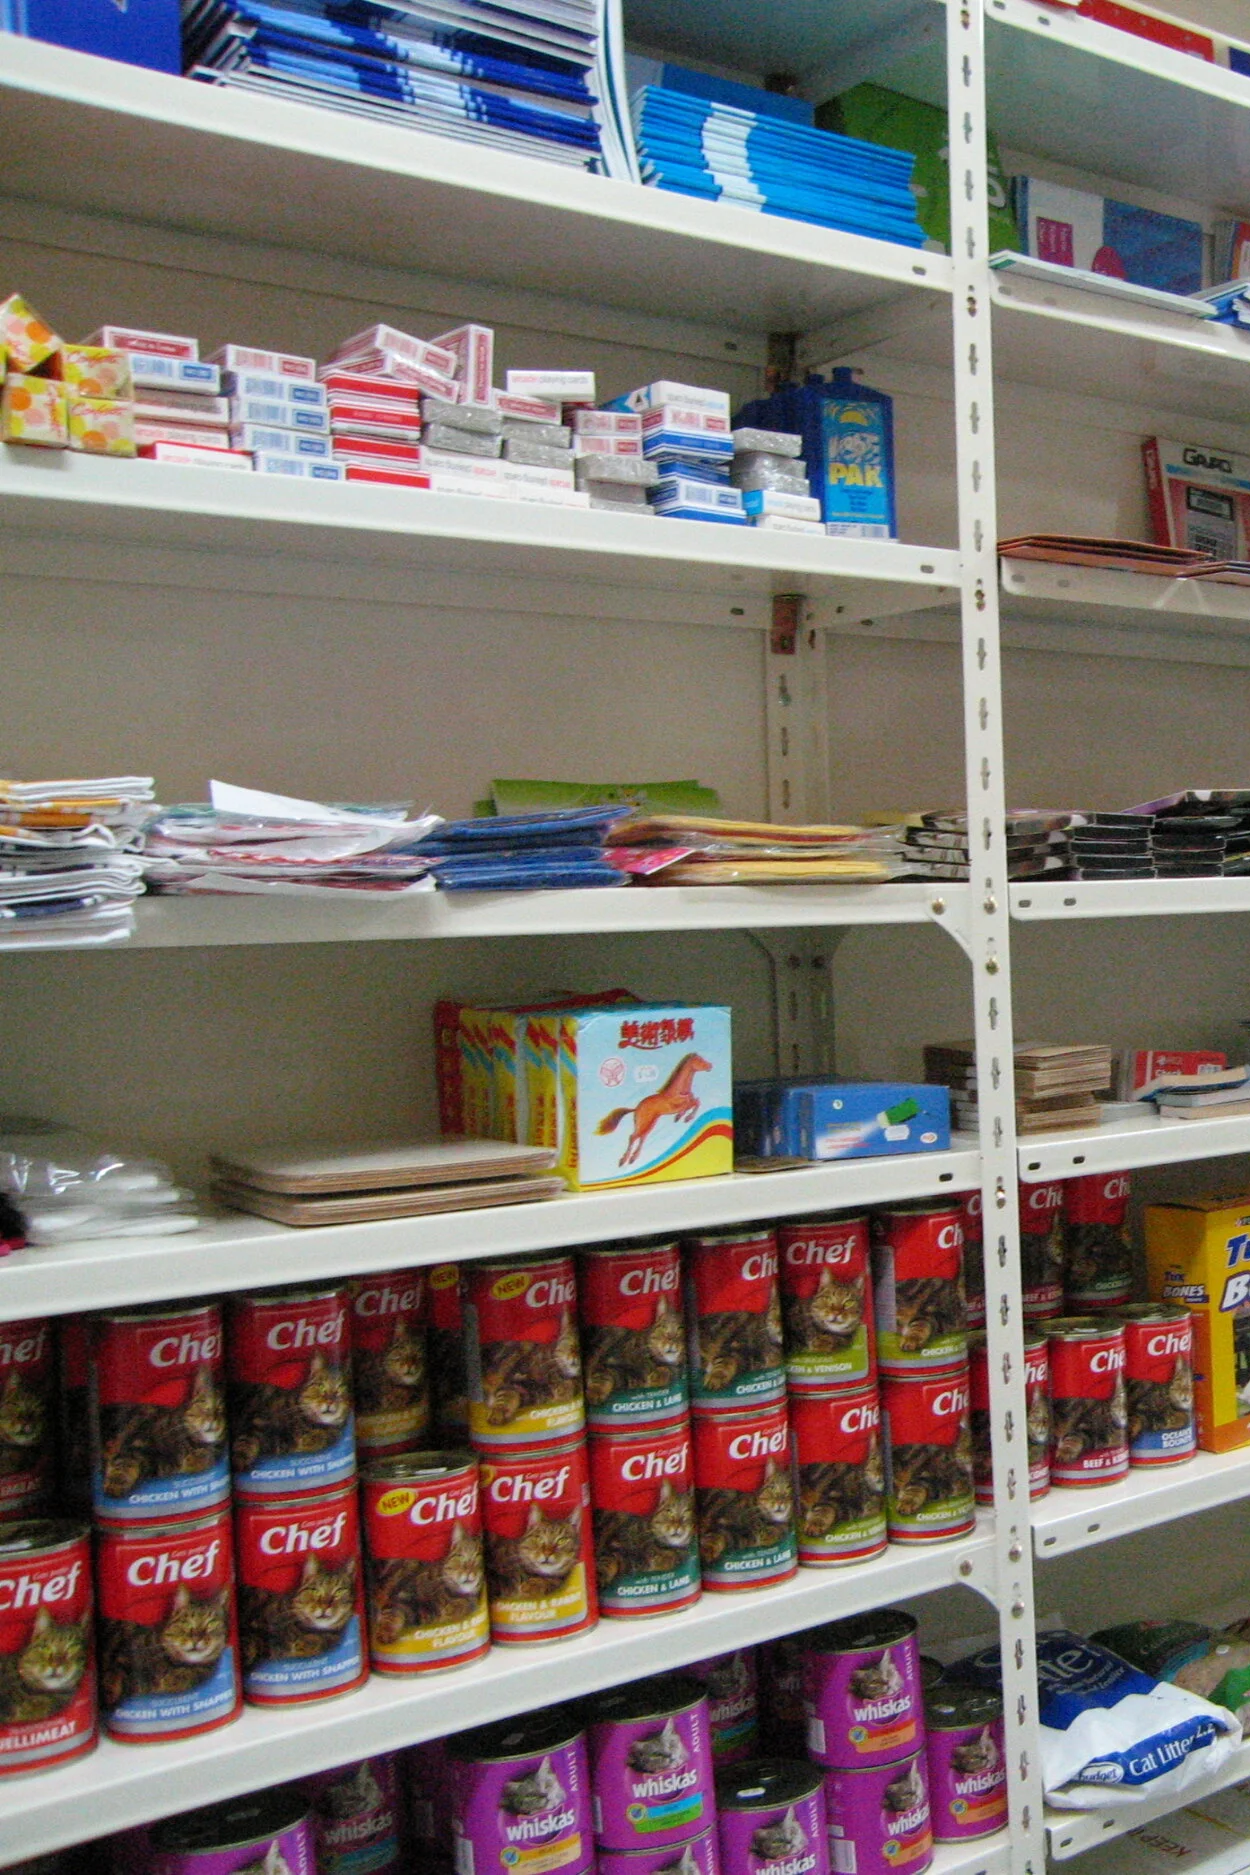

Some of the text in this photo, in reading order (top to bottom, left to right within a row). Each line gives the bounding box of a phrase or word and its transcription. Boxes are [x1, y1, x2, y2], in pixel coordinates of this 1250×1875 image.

[828, 462, 884, 487] PAK
[787, 1235, 856, 1266] Chef
[496, 1275, 527, 1295] NEW
[525, 1276, 577, 1309] Che
[267, 1308, 345, 1350] Chef
[813, 1362, 852, 1374] VENISON
[1090, 1348, 1128, 1374] Che
[611, 1400, 655, 1413] CHICKEN
[250, 1462, 326, 1481] CHICKEN WITH
[620, 1442, 688, 1482] Chef
[1083, 1458, 1105, 1469] BEEF
[128, 1489, 179, 1505] CHICKEN
[180, 1482, 209, 1499] WITH
[490, 1465, 571, 1502] Chef
[381, 1491, 412, 1511] NEW
[409, 1480, 479, 1526] Chef
[260, 1511, 347, 1556] Chef
[824, 1530, 862, 1544] CHICKEN
[127, 1539, 221, 1587] Chef
[724, 1558, 764, 1572] CHICKEN
[0, 1560, 83, 1611] Chef
[616, 1583, 660, 1598] CHICKEN
[413, 1623, 461, 1641] CHICKEN
[291, 1667, 321, 1683] WITH
[159, 1701, 191, 1717] WITH
[853, 1695, 912, 1722] whiskas
[690, 1713, 702, 1753] ADULT
[1128, 1754, 1156, 1777] Cat
[1157, 1735, 1195, 1769] Litter
[568, 1750, 579, 1792] ADULT
[632, 1768, 698, 1799] whiskas
[324, 1811, 393, 1846] whiskas
[507, 1808, 575, 1842] whiskas
[809, 1800, 819, 1838] ADULT
